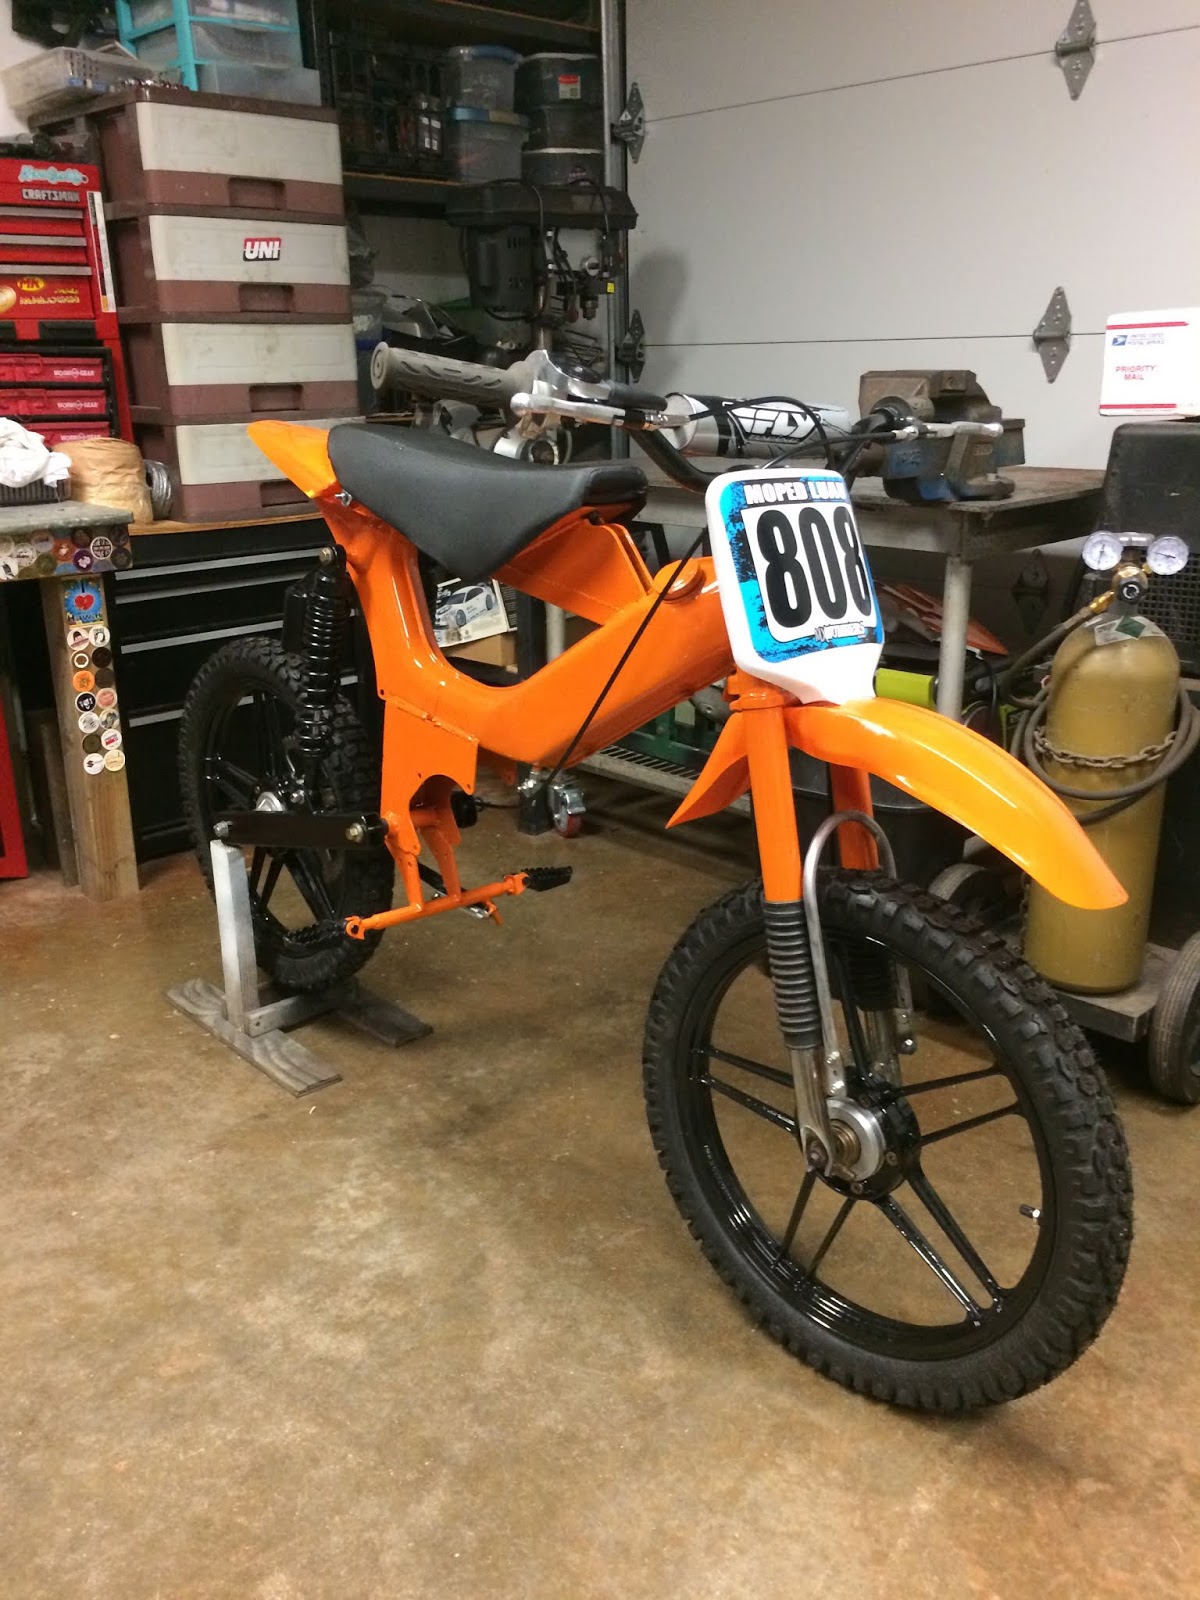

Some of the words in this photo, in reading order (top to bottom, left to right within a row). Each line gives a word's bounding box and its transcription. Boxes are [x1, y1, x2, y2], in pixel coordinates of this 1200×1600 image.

[22, 188, 80, 202] CRAFTSMAN
[245, 240, 280, 260] UNI
[1115, 364, 1157, 373] PRIORITY
[1123, 373, 1144, 381] MAIL
[744, 481, 808, 504] MOPED
[756, 506, 872, 628] 808
